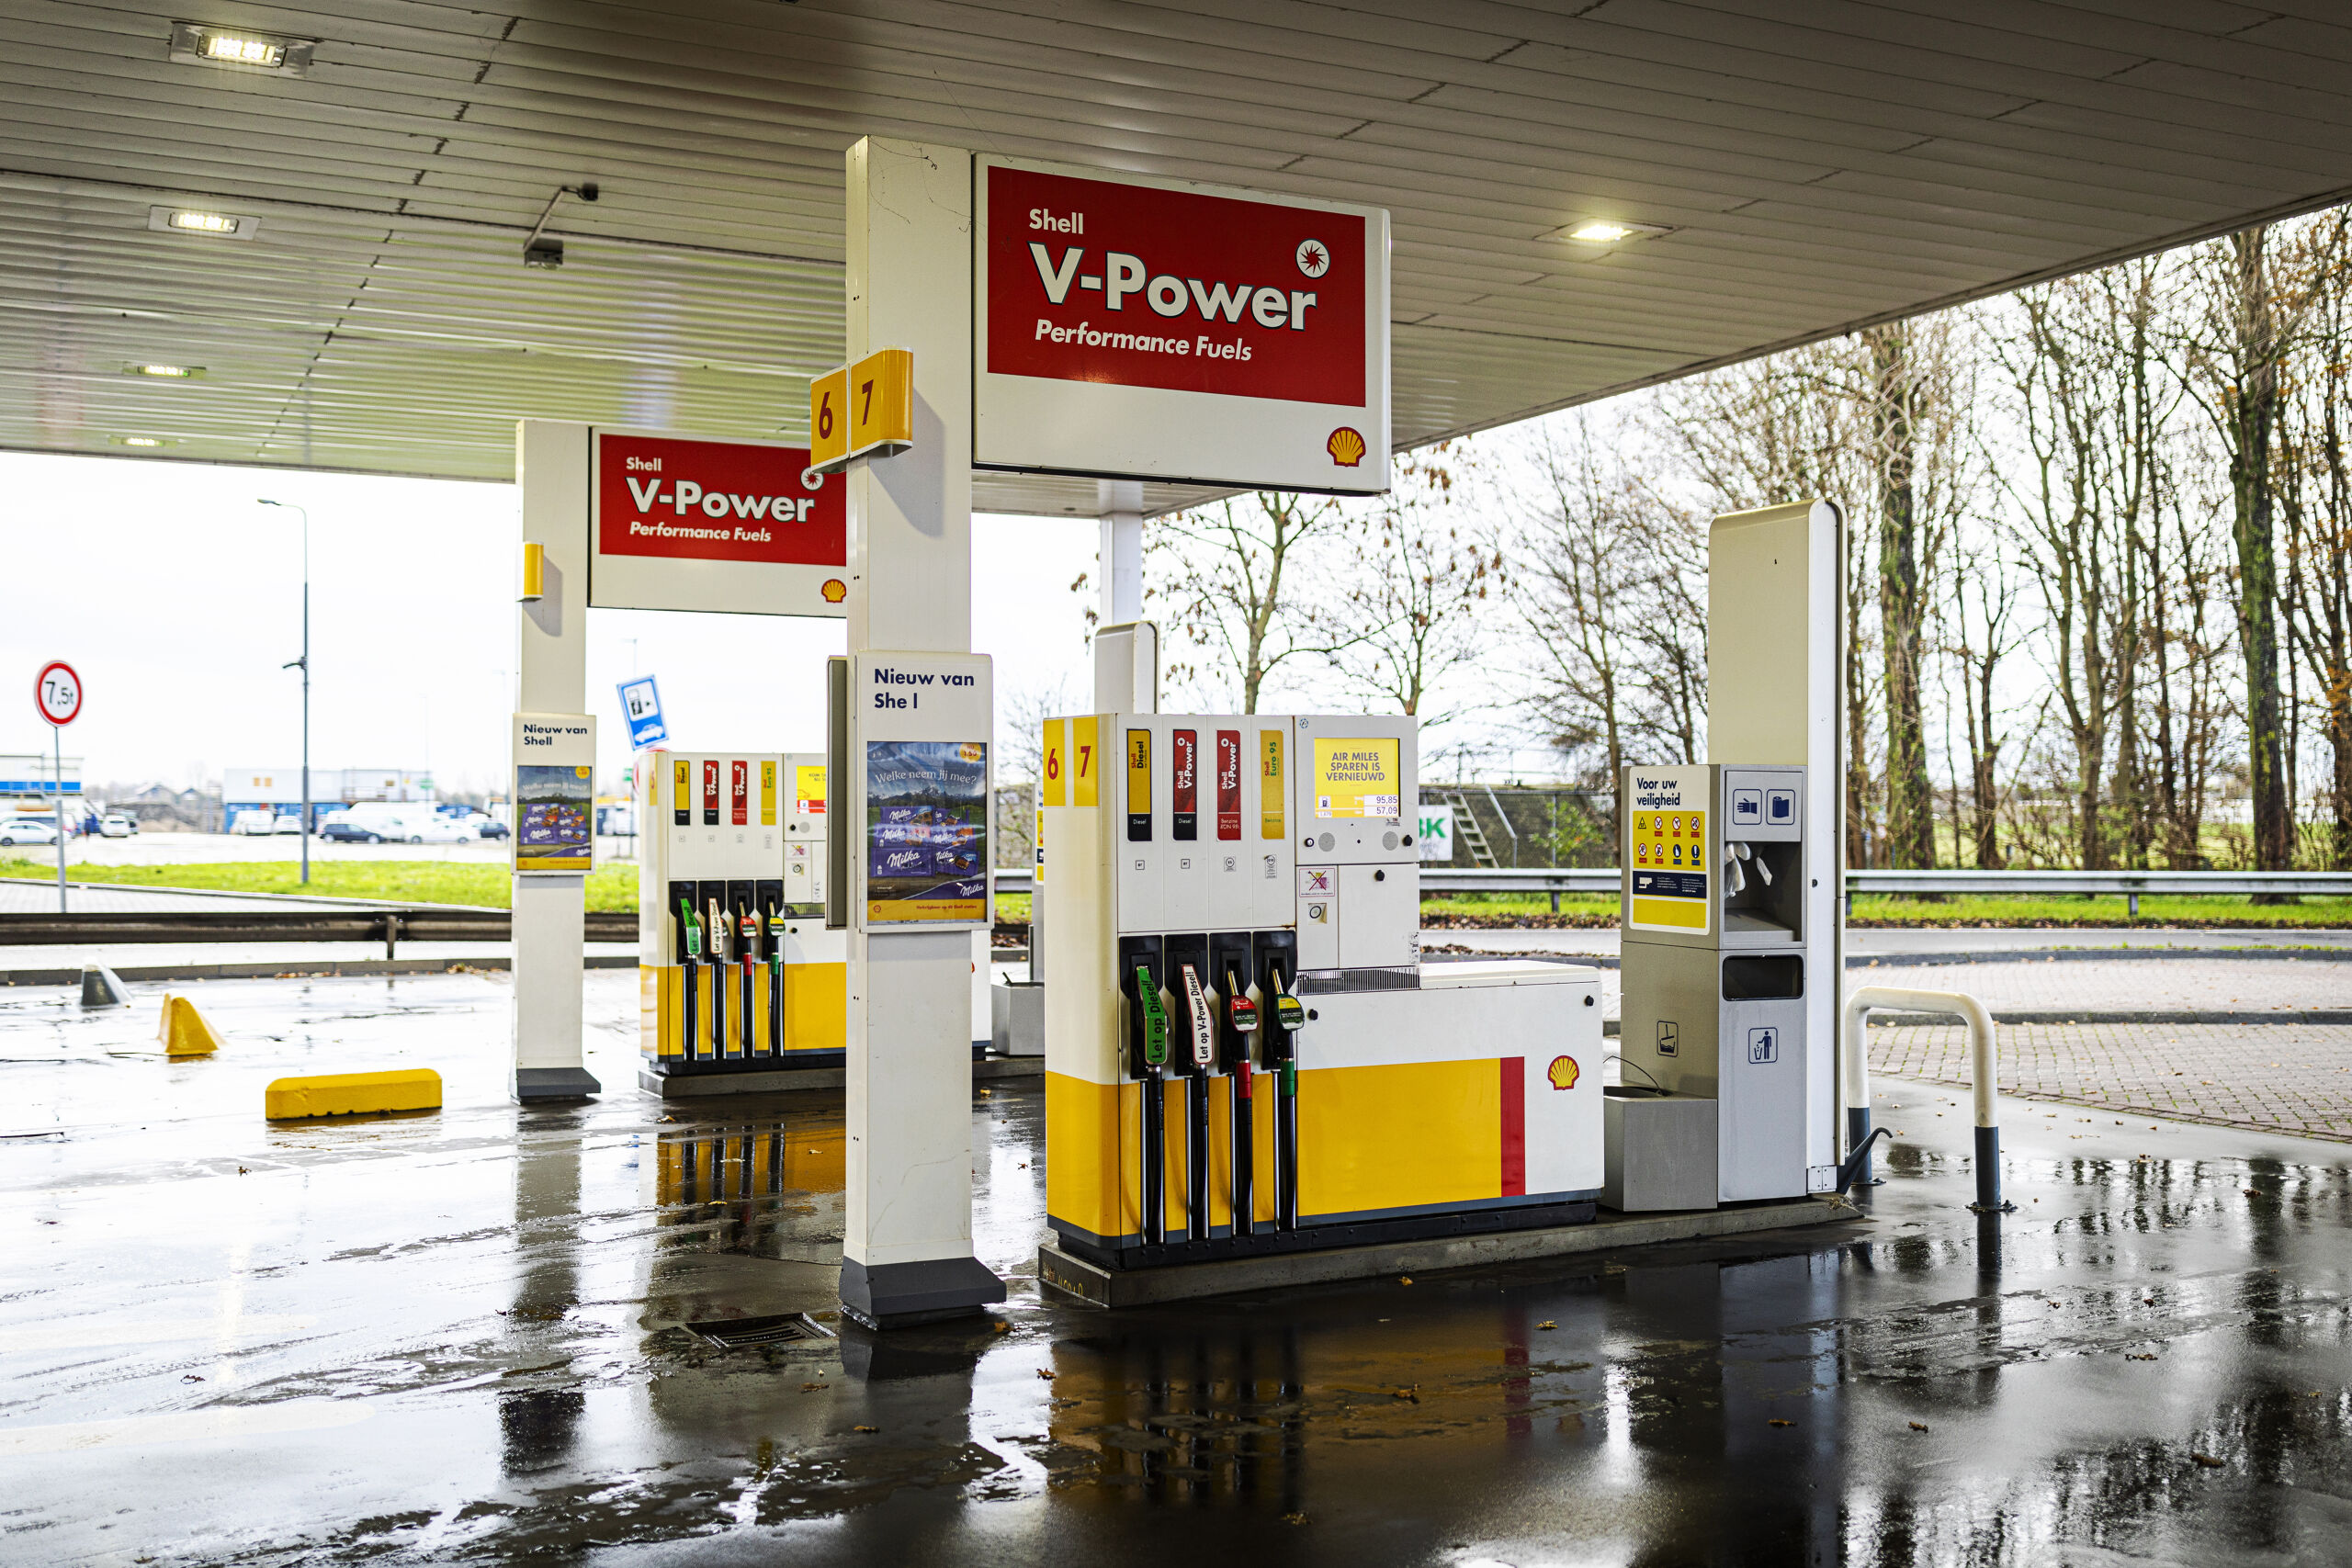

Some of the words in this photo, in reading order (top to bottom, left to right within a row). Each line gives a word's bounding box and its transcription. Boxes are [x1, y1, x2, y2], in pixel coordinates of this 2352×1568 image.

[1028, 208, 1084, 234] Shell
[1027, 241, 1317, 332] V-Power
[1035, 319, 1190, 355] Performance
[1195, 335, 1251, 361] Fuels
[861, 379, 875, 426] 7
[818, 391, 833, 440] 6
[626, 457, 662, 472] Shell
[625, 476, 815, 523] V-Power
[629, 521, 730, 540] Performance
[733, 525, 772, 543] Fuels
[874, 668, 935, 686] Nieuw
[941, 672, 975, 687] van
[874, 693, 918, 709] Shel
[524, 724, 562, 734] Nieuw
[566, 727, 588, 735] van
[524, 737, 552, 746] Shell
[1270, 741, 1277, 754] 95
[1047, 748, 1058, 780] 6
[1080, 745, 1091, 778] 7
[1331, 752, 1349, 761] AIR
[1351, 751, 1379, 761] MILES
[1184, 741, 1193, 789] V-Power
[1228, 742, 1237, 790] V-Power
[1330, 761, 1368, 772] SPAREN
[1372, 761, 1381, 772] IS
[875, 771, 906, 784] Welke
[909, 771, 936, 779] neem
[938, 770, 948, 781] jij
[950, 773, 978, 784] mee?
[1326, 772, 1385, 782] VERNIEUWD
[1636, 777, 1658, 790] Voor
[1662, 780, 1678, 789] uw
[1376, 795, 1397, 805] 95,85
[1636, 793, 1680, 808] veiligheid
[889, 809, 911, 820] Milka
[1376, 807, 1397, 816] 57,09
[887, 851, 920, 867] Milka
[960, 884, 984, 897] Milka
[1185, 971, 1200, 997] Diesel!
[1141, 979, 1161, 1013] Diesel!
[1194, 998, 1206, 1031] V-Power
[1154, 1018, 1165, 1034] op
[1201, 1032, 1209, 1044] op
[1151, 1039, 1163, 1059] Let
[1199, 1045, 1208, 1059] Let
